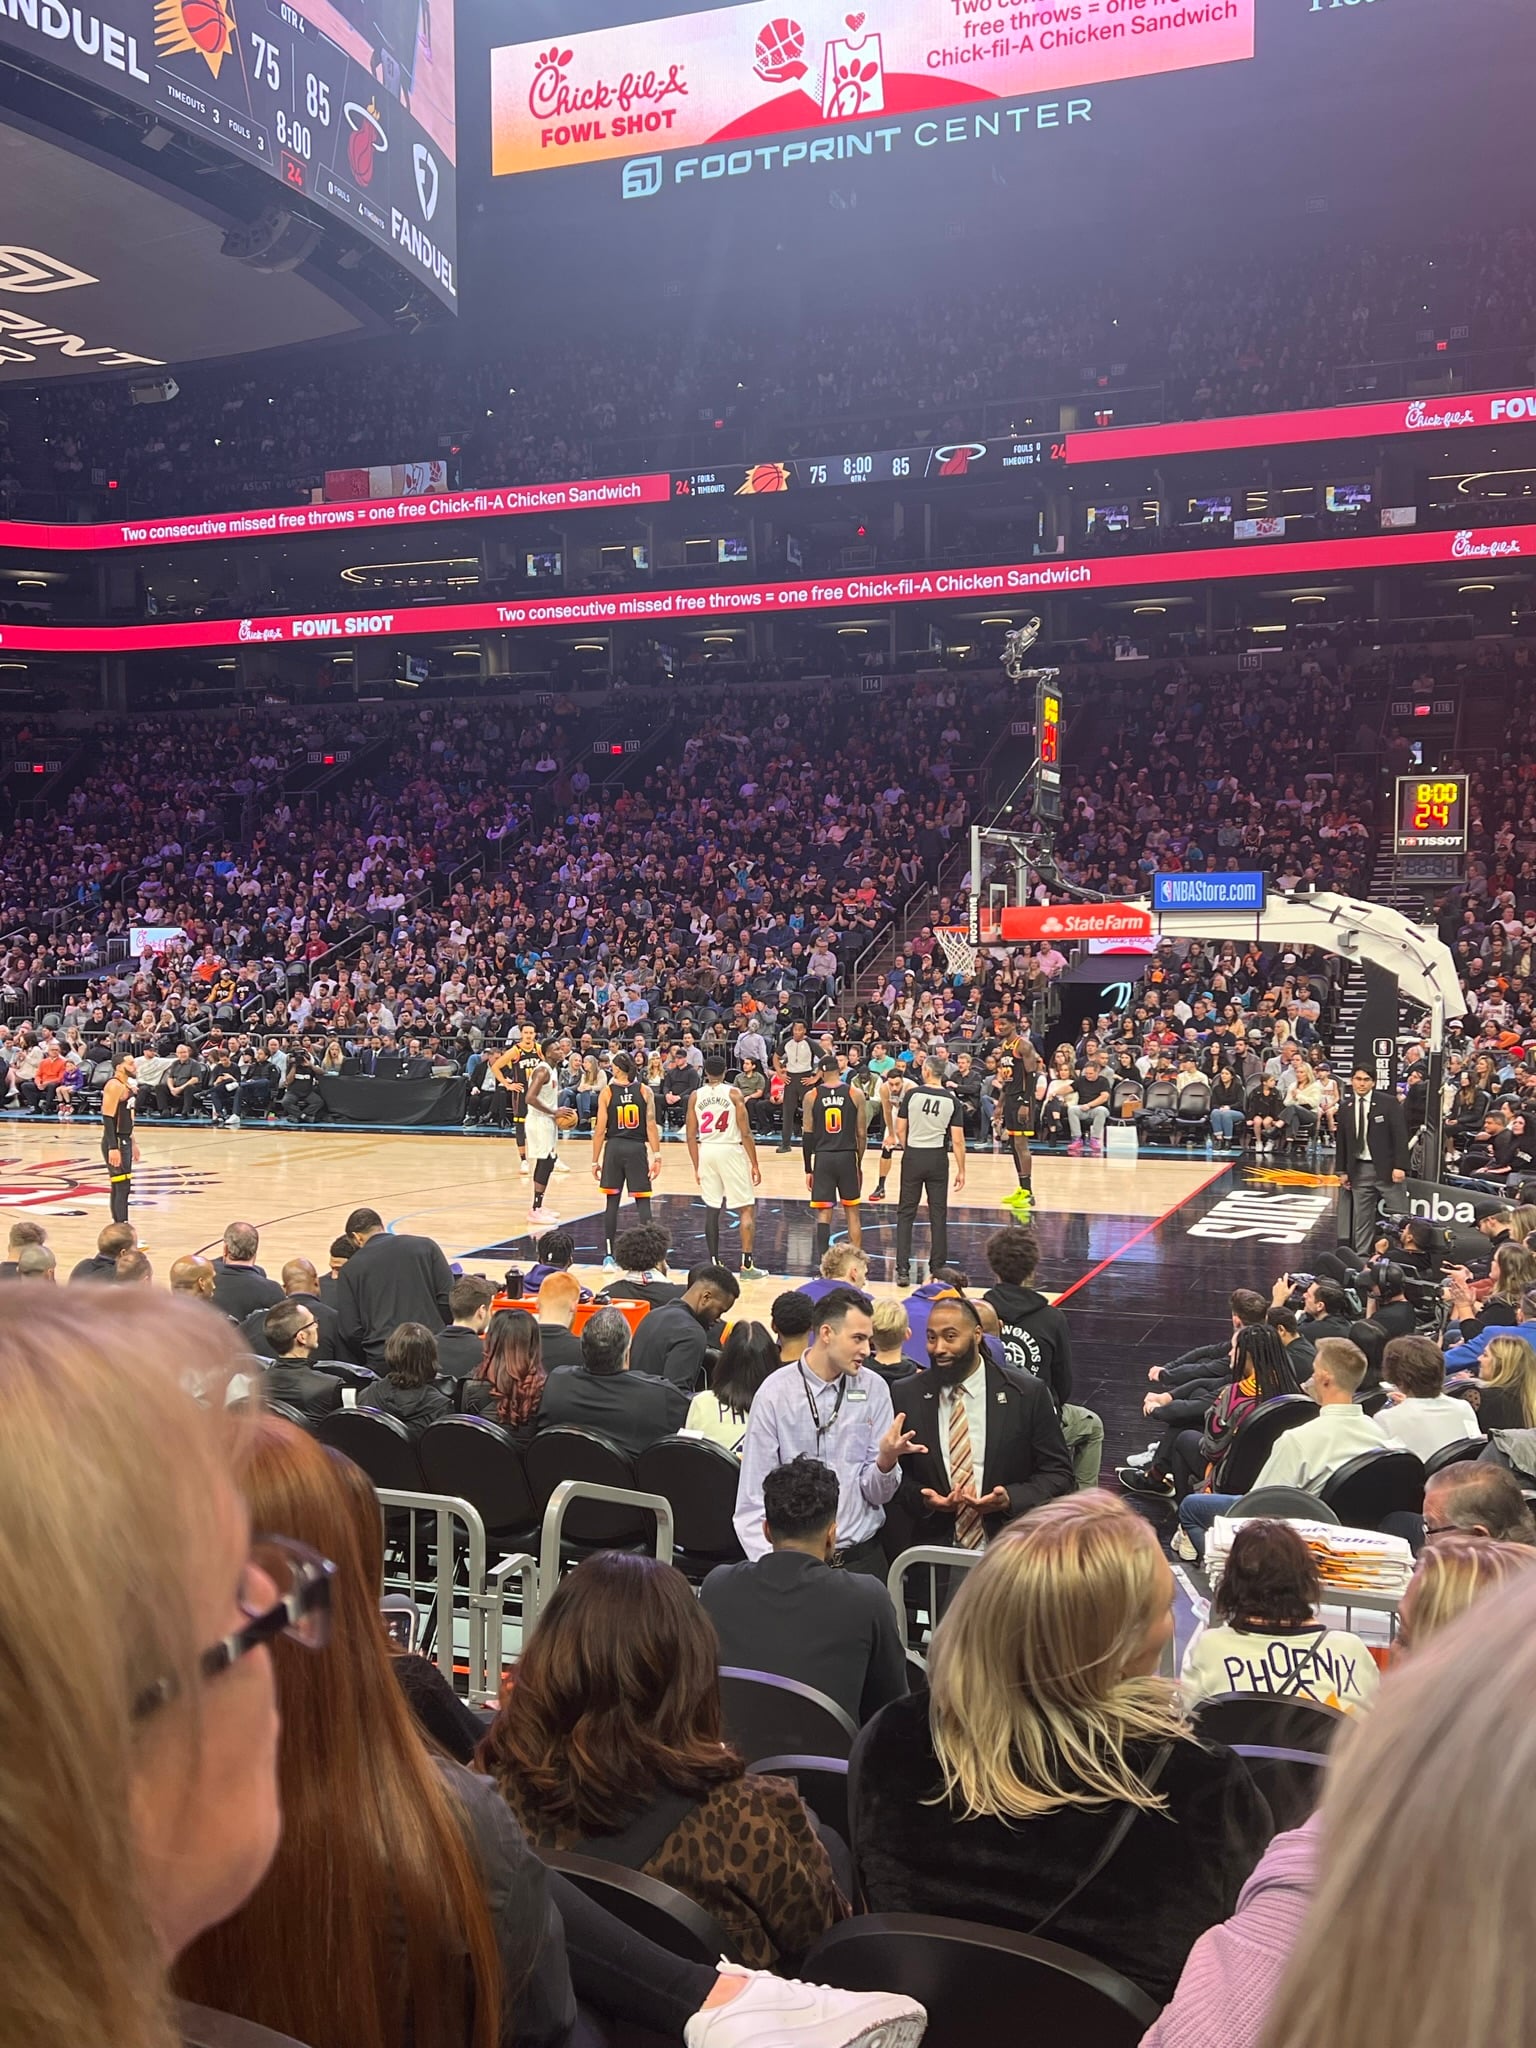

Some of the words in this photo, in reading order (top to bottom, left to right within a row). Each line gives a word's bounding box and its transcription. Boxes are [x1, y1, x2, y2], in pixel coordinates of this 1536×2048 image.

[280, 3, 298, 29] QTR
[299, 17, 305, 34] 4
[963, 19, 1005, 38] free
[1010, 5, 1082, 30] throws
[1106, 0, 1147, 14] one
[926, 34, 1034, 69] Chick-fil-A
[1040, 21, 1125, 50] Chicken
[1131, 0, 1237, 35] Sandwich
[251, 32, 280, 91] 75
[306, 73, 331, 126] 85
[529, 60, 688, 119] Chick-fil-A
[167, 85, 206, 113] TIMEOUTS
[212, 109, 220, 124] 3
[228, 119, 251, 139] FOULS
[257, 136, 265, 151] 3
[541, 121, 606, 148] FOWL
[611, 108, 677, 137] SHOT
[276, 110, 311, 160] 8:00
[675, 127, 902, 183] FOOTPRINT
[914, 98, 1092, 147] CENTER
[287, 162, 303, 186] 24
[391, 206, 457, 296] FANDUEL
[1013, 443, 1034, 454] FOULS
[843, 455, 873, 475] 8:00
[892, 457, 910, 476] 85
[1003, 454, 1034, 467] TIMEOUTS
[809, 465, 827, 484] 75
[676, 480, 690, 495] 24
[697, 484, 726, 495] TIMEOUTS
[121, 527, 147, 542] Two
[149, 519, 227, 539] consecutive
[229, 514, 276, 532] missed
[278, 513, 306, 527] free
[308, 509, 355, 525] throws
[369, 507, 395, 520] one
[398, 503, 426, 517] free
[429, 495, 504, 514] Chick-fil-A
[507, 490, 566, 508] Chicken
[568, 482, 641, 503] Sandwich
[497, 607, 526, 622] Two
[528, 601, 616, 620] consecutive
[619, 596, 672, 614] missed
[676, 594, 706, 610] free
[709, 592, 761, 608] throws
[778, 589, 808, 603] one
[811, 585, 843, 601] free
[847, 577, 932, 598] Chick-fil-A
[936, 573, 1003, 592] Chicken
[1007, 566, 1091, 586] Sandwich
[292, 619, 342, 637] FOWL
[345, 615, 394, 633] SHOT
[1243, 656, 1258, 667] 115
[865, 679, 878, 689] 114
[1417, 783, 1458, 804] 8:00
[1414, 803, 1449, 830] 24
[1418, 836, 1463, 846] TISSOT
[1172, 880, 1256, 902] NBAStore.com
[1376, 1058, 1390, 1069] GET
[1376, 1069, 1390, 1079] THE
[1375, 1080, 1390, 1090] APP
[620, 1094, 634, 1103] LEE
[821, 1096, 845, 1107] CRAIG
[922, 1098, 941, 1117] 44
[617, 1104, 639, 1130] 10
[700, 1110, 729, 1134] 24
[824, 1107, 842, 1134] 0
[1223, 1641, 1361, 1698] PHOENIX
